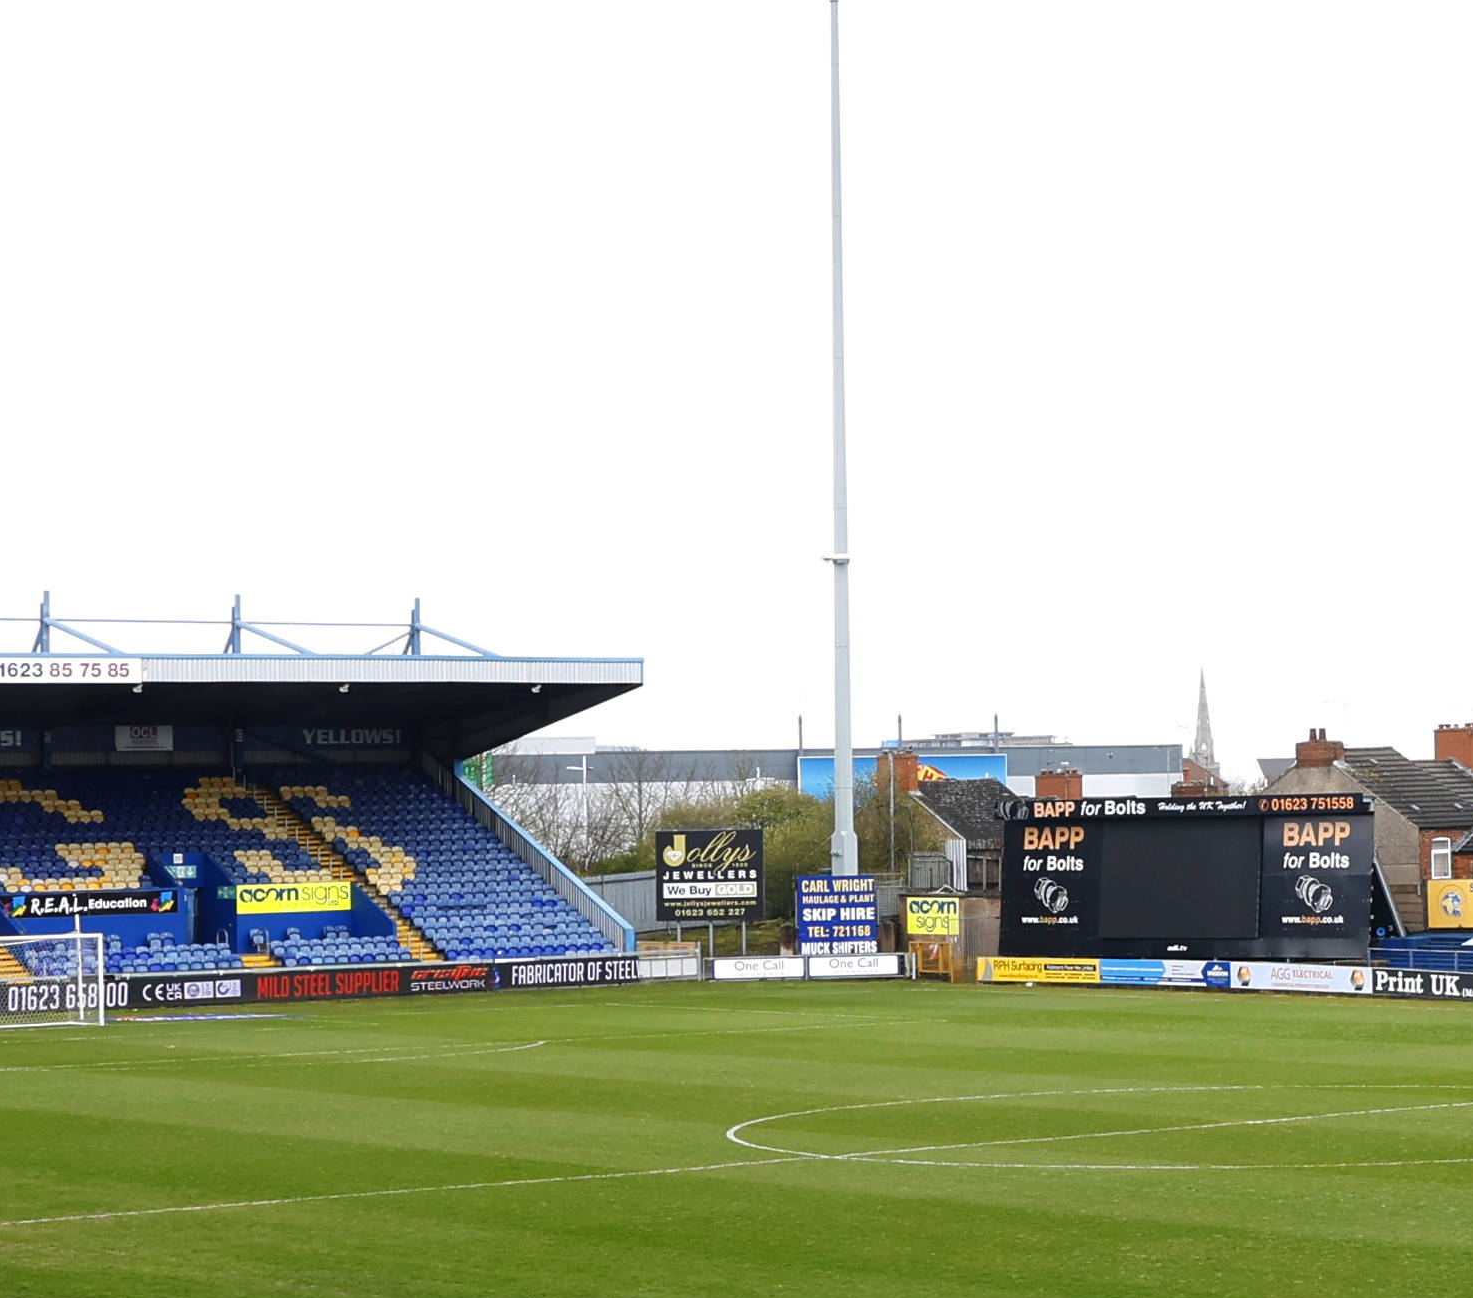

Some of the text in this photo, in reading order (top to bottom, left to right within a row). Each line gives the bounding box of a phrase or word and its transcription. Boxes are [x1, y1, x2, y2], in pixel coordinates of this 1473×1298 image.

[1034, 800, 1146, 817] BAPP for Bolts
[1023, 827, 1085, 850] BAPP
[663, 831, 756, 874] Jollys
[1023, 856, 1083, 871] for Bolts
[663, 870, 757, 879] JEWELLERS
[802, 879, 874, 893] CARL WRIGHT
[803, 907, 874, 921] SKIP HIRE
[833, 941, 877, 954] SHIFTERS
[1376, 971, 1423, 993] Print
